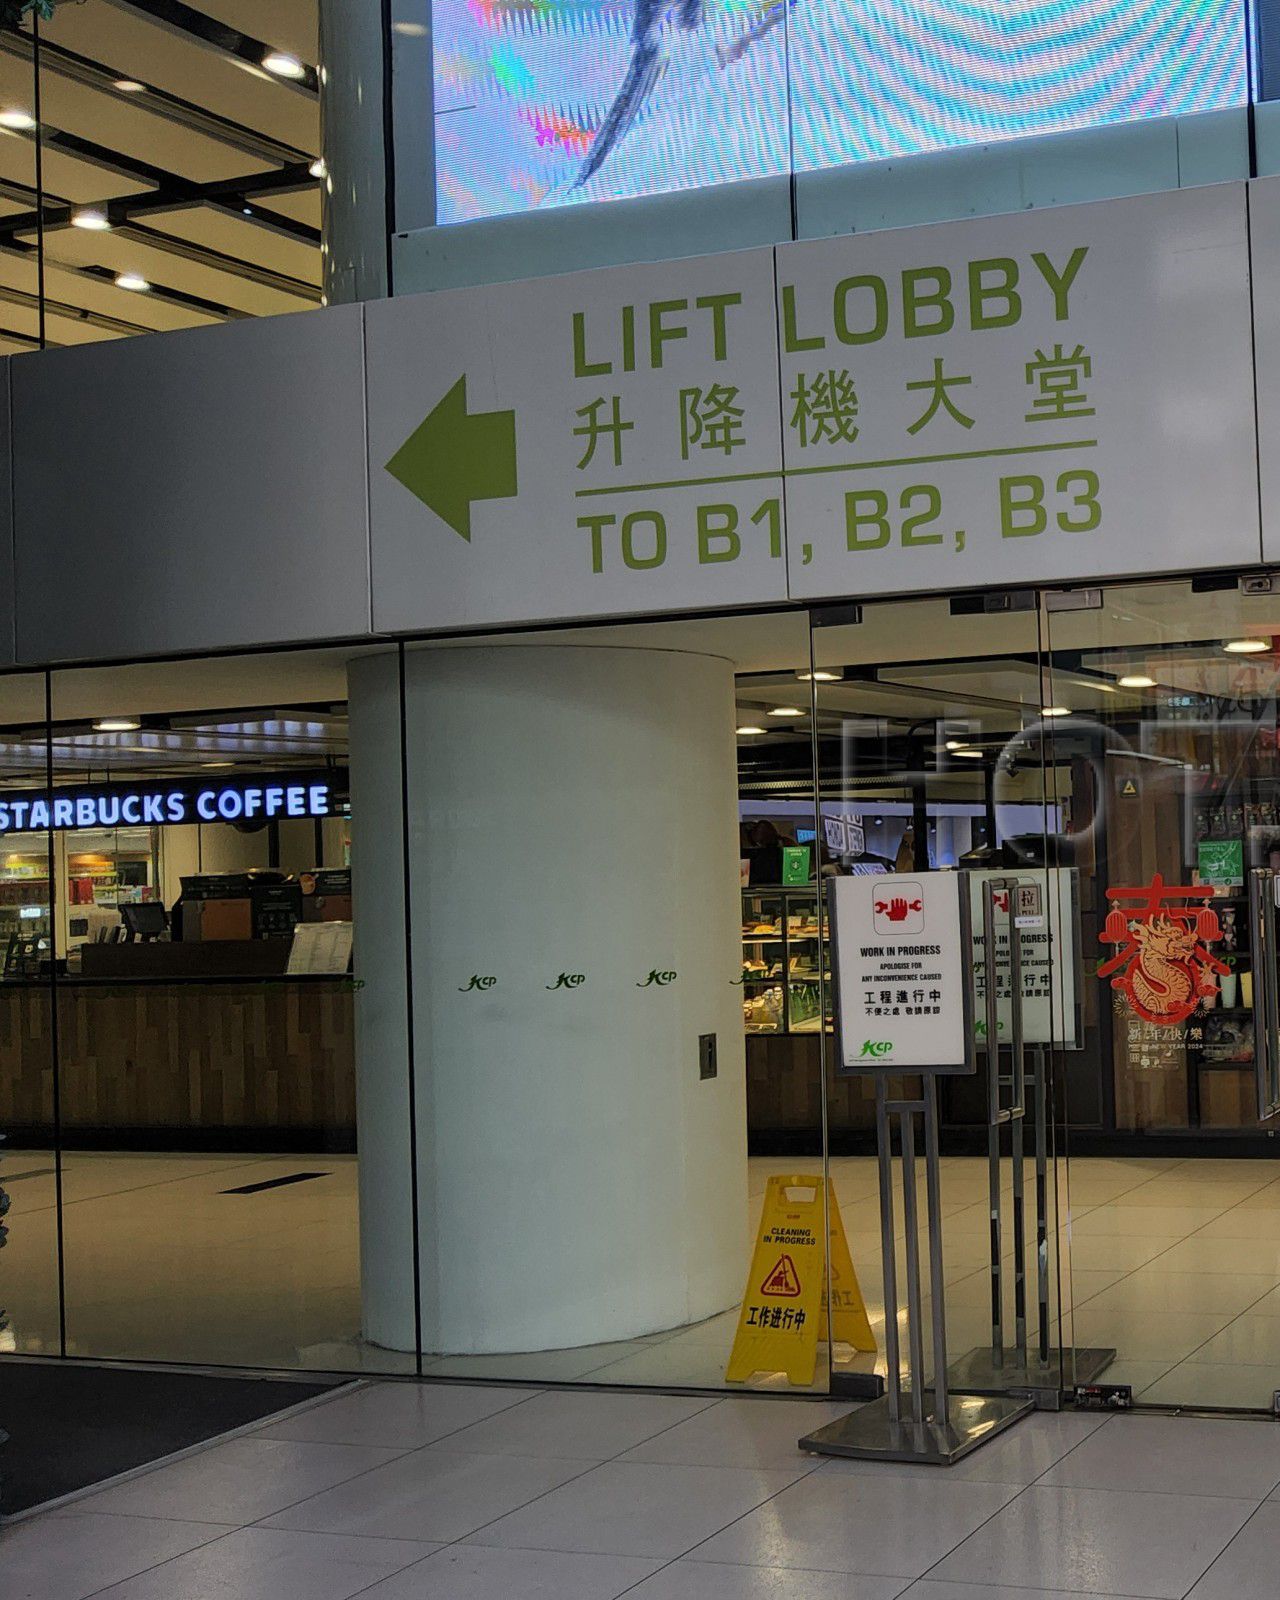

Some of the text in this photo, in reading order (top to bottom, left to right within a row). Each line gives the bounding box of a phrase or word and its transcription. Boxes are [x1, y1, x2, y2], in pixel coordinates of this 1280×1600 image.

[572, 246, 1089, 378] LIFT LOBBY
[575, 343, 1097, 470] 升降機大堂
[576, 509, 667, 573] TO
[844, 484, 966, 552] B2,
[999, 469, 1102, 538] B3
[0, 786, 329, 830] STARBUCKS COFFEE
[1021, 890, 1034, 906] 拉
[1020, 934, 1053, 943] OGRESS
[860, 945, 941, 957] WORK IN PROGRESS
[874, 974, 918, 982] INCONVENIENCE
[864, 989, 941, 1004] 工程進行中
[771, 1227, 811, 1237] CLEANING
[763, 1235, 816, 1246] IN PROGRESS
[746, 1307, 806, 1331] 工作进行中
